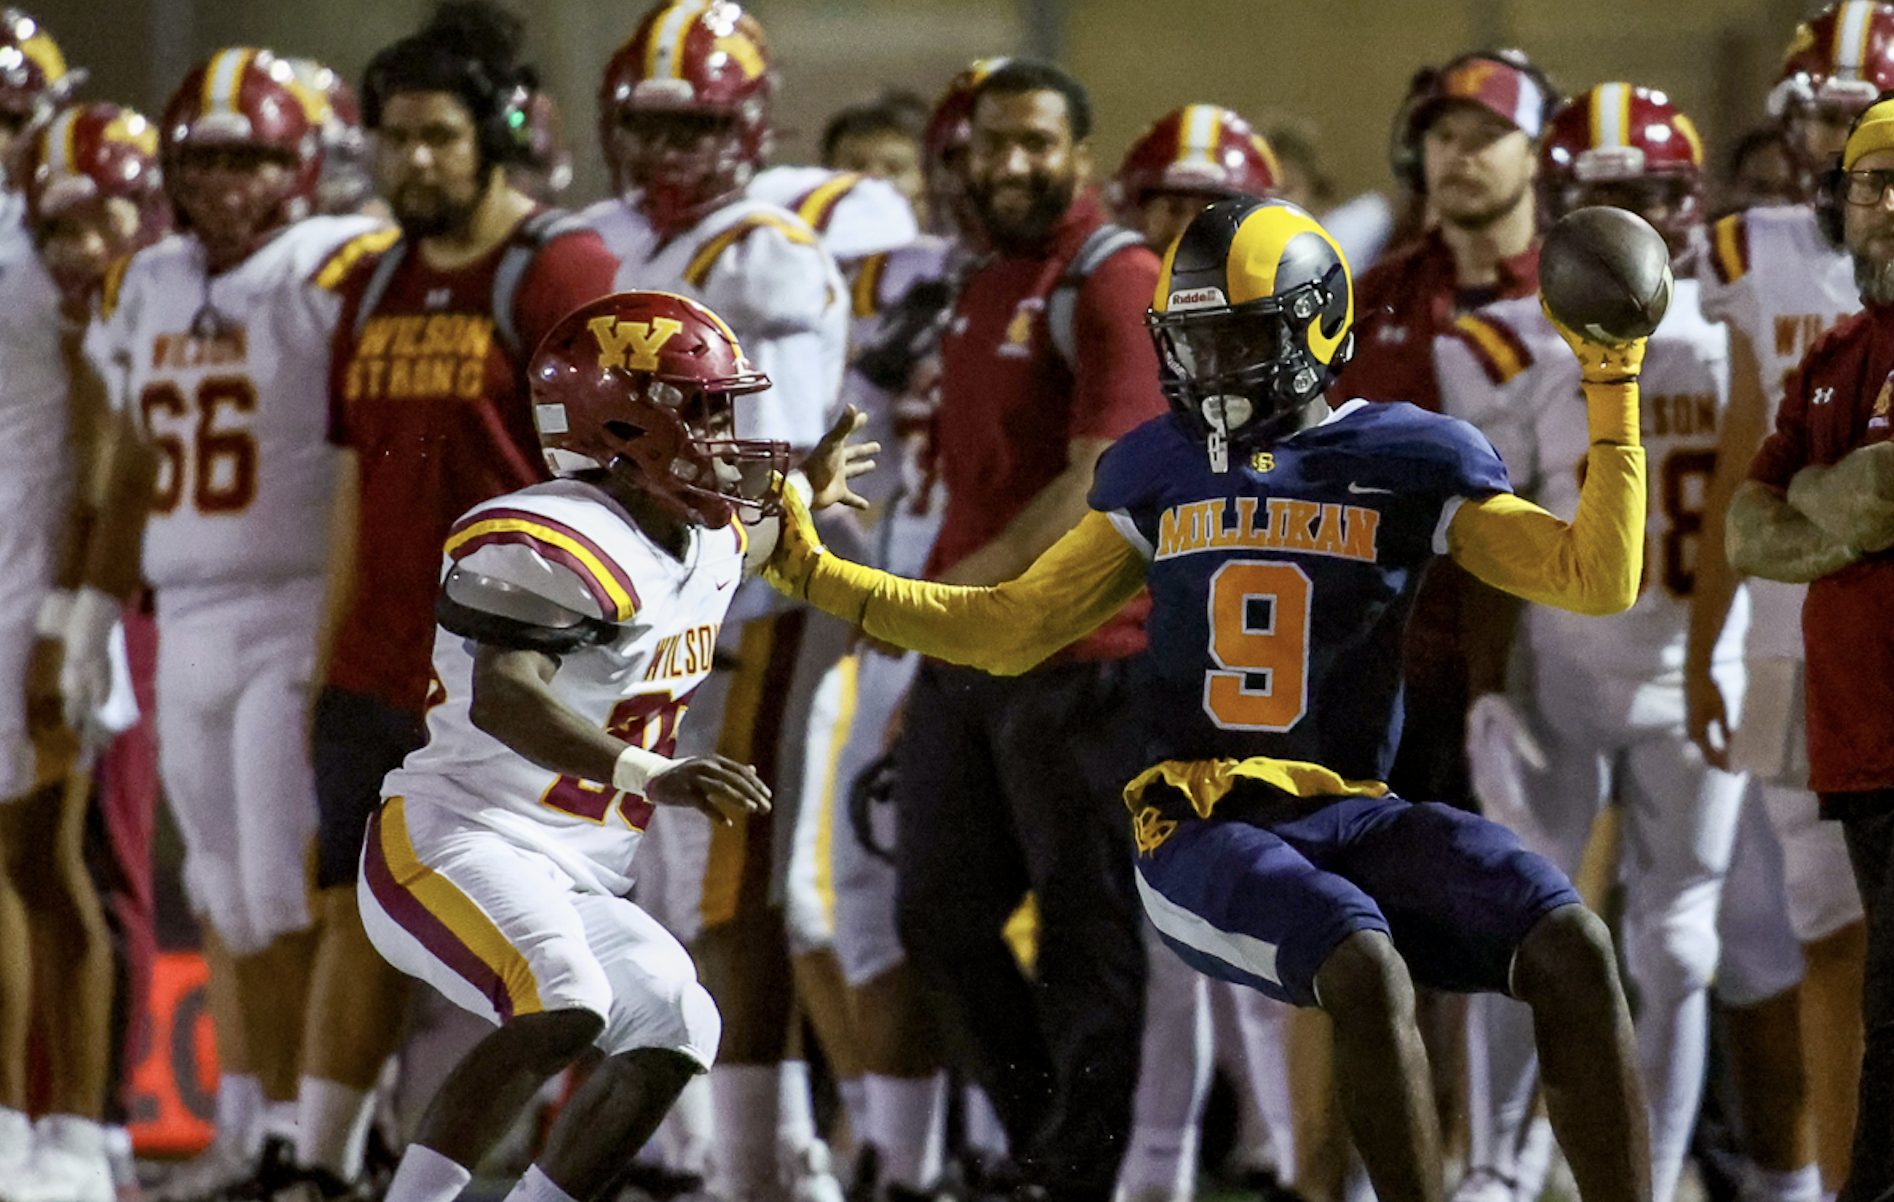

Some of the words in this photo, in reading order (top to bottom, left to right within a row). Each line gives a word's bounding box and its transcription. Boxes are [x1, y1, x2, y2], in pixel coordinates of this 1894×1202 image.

[587, 315, 683, 371] W
[346, 357, 484, 400] STRONG
[140, 375, 258, 516] 66
[1154, 497, 1380, 563] MILLIKAN
[643, 623, 720, 682] WILSO
[1202, 559, 1314, 733] 9
